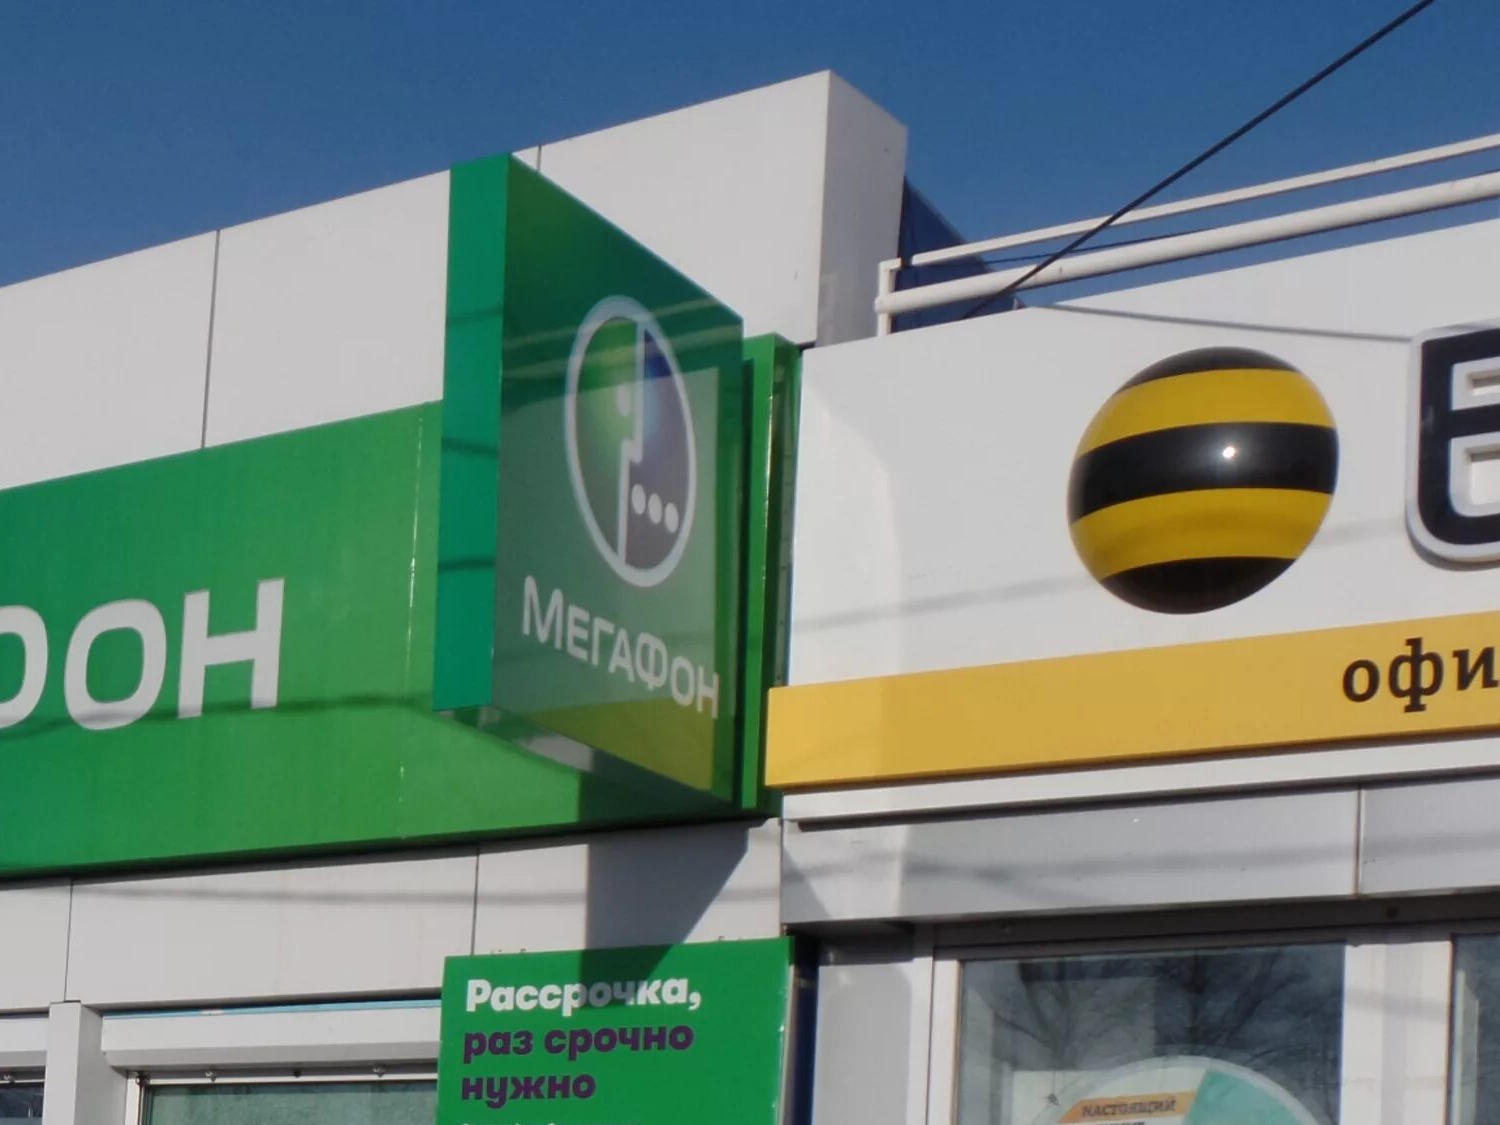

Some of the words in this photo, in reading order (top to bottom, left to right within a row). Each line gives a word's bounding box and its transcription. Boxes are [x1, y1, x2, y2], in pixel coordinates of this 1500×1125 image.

[521, 576, 719, 718] МЕГАФОН
[1342, 637, 1500, 713] офи
[466, 978, 702, 1017] Рассрочка,
[463, 1029, 534, 1064] раз
[544, 1025, 695, 1061] срочно
[461, 1074, 596, 1109] нужно
